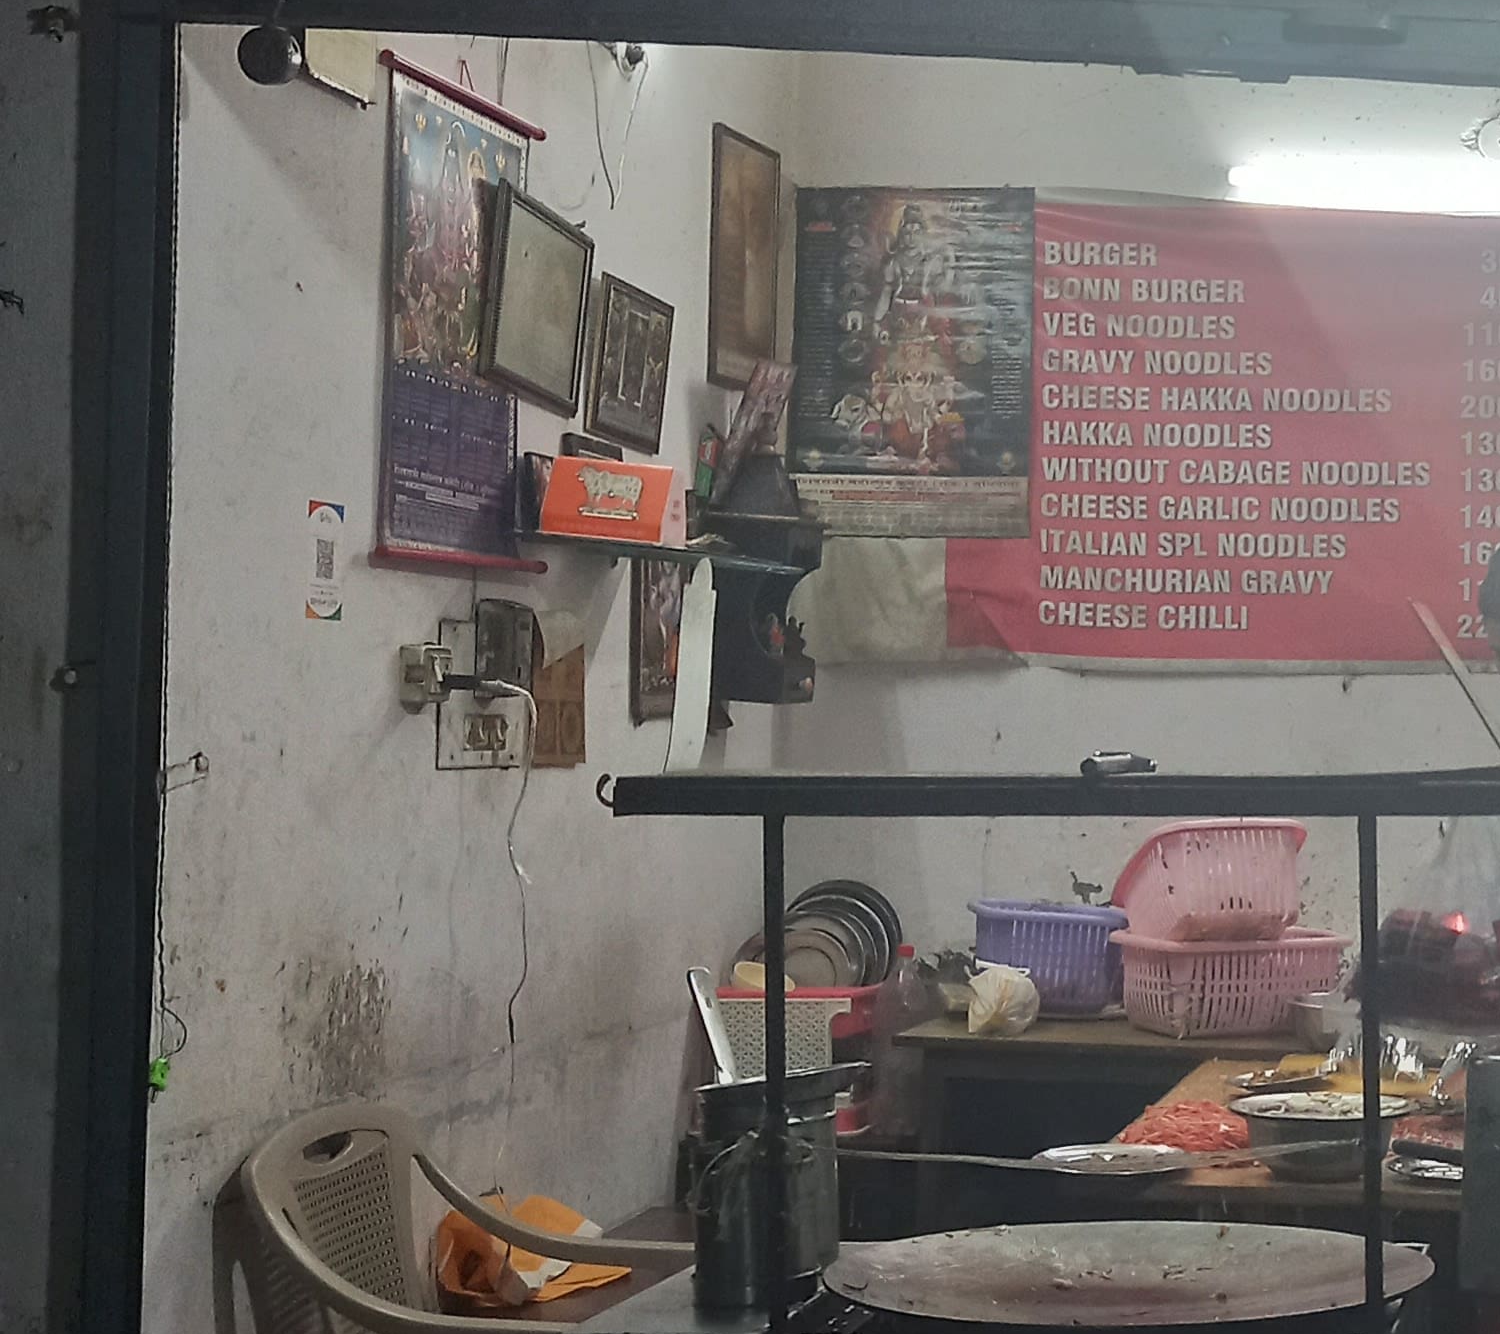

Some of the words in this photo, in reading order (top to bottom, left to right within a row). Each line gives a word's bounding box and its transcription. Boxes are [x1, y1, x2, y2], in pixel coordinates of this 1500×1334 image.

[1043, 241, 1158, 267] BURGER
[1043, 277, 1121, 302] BONN
[1132, 279, 1245, 305] BURGER
[1043, 313, 1096, 338] VEG
[1107, 314, 1236, 340] NOODLES
[1043, 348, 1135, 375] GRAVY
[1145, 350, 1273, 376] NOODLES
[1042, 384, 1150, 411] CHEESE
[1161, 386, 1254, 412] HAKKA
[1263, 388, 1392, 414] NOODLES
[1042, 421, 1133, 447] HAKKA
[1144, 422, 1273, 449] NOODLES
[1042, 457, 1169, 484] WITHOUT
[1179, 459, 1291, 486] CABAGE
[1301, 461, 1431, 487] NOODLES
[1040, 493, 1148, 520] CHEESE
[1159, 495, 1260, 521] GARLIC
[1270, 497, 1400, 523] NOODLES
[1040, 529, 1147, 556] ITALIAN
[1157, 531, 1208, 558] SPL
[1217, 533, 1347, 559] NOODLES
[1039, 565, 1231, 593] MANCHURIAN
[1241, 568, 1334, 595] GRAVY
[1038, 600, 1148, 628] CHEESE
[1158, 604, 1249, 631] CHILLI
